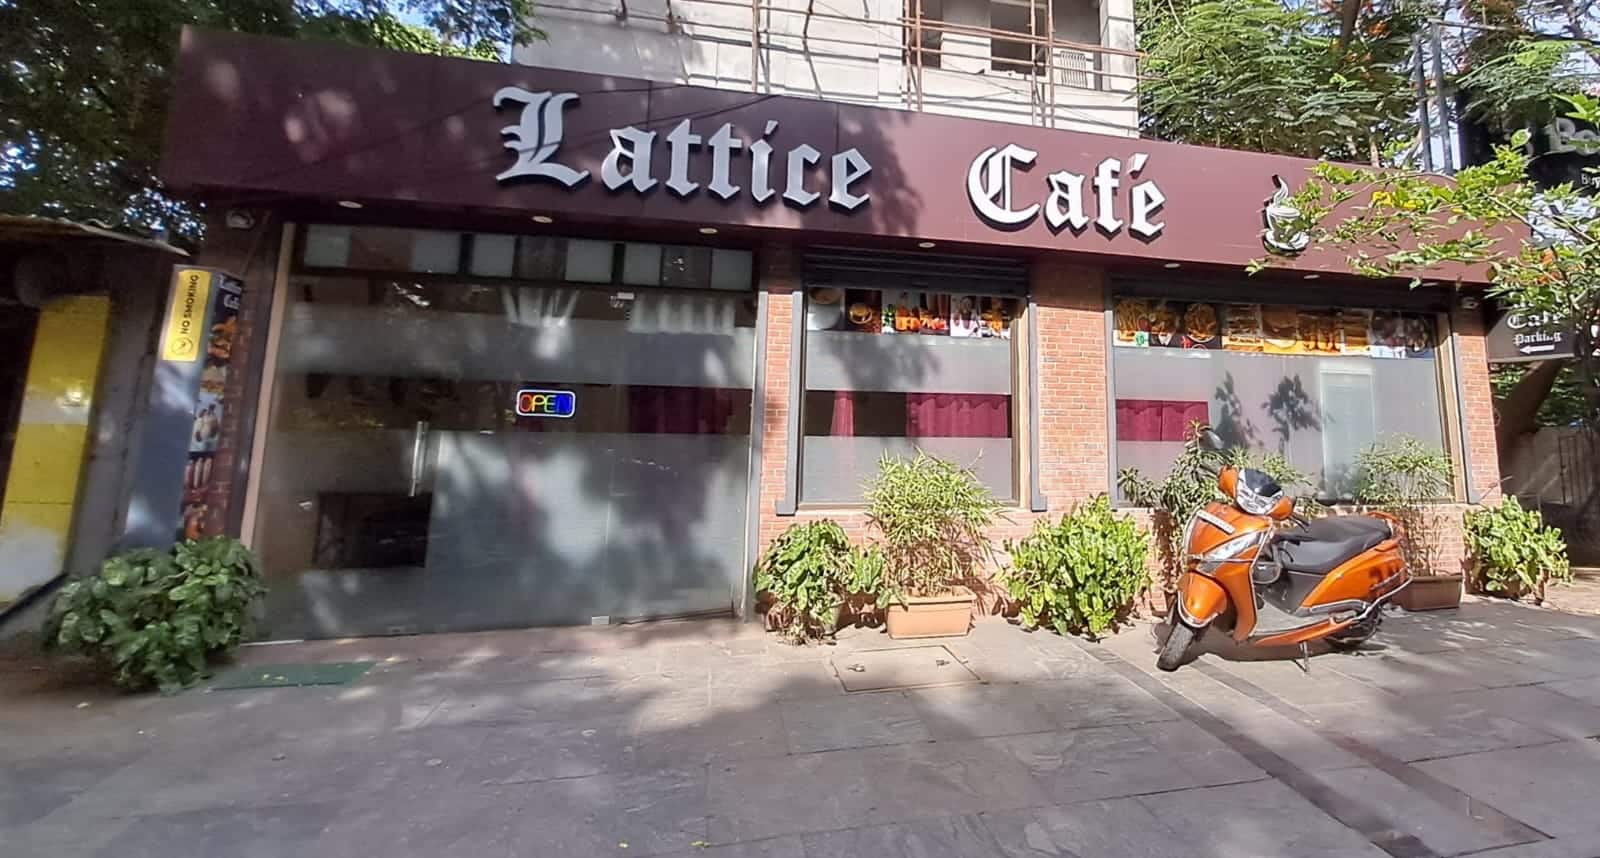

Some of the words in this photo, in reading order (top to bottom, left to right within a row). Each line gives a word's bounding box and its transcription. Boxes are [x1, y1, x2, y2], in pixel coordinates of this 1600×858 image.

[493, 86, 873, 210] Lattice
[967, 143, 1167, 240] Café
[184, 274, 201, 319] SMOKING
[180, 320, 191, 335] NO
[520, 394, 573, 413] OPEN
